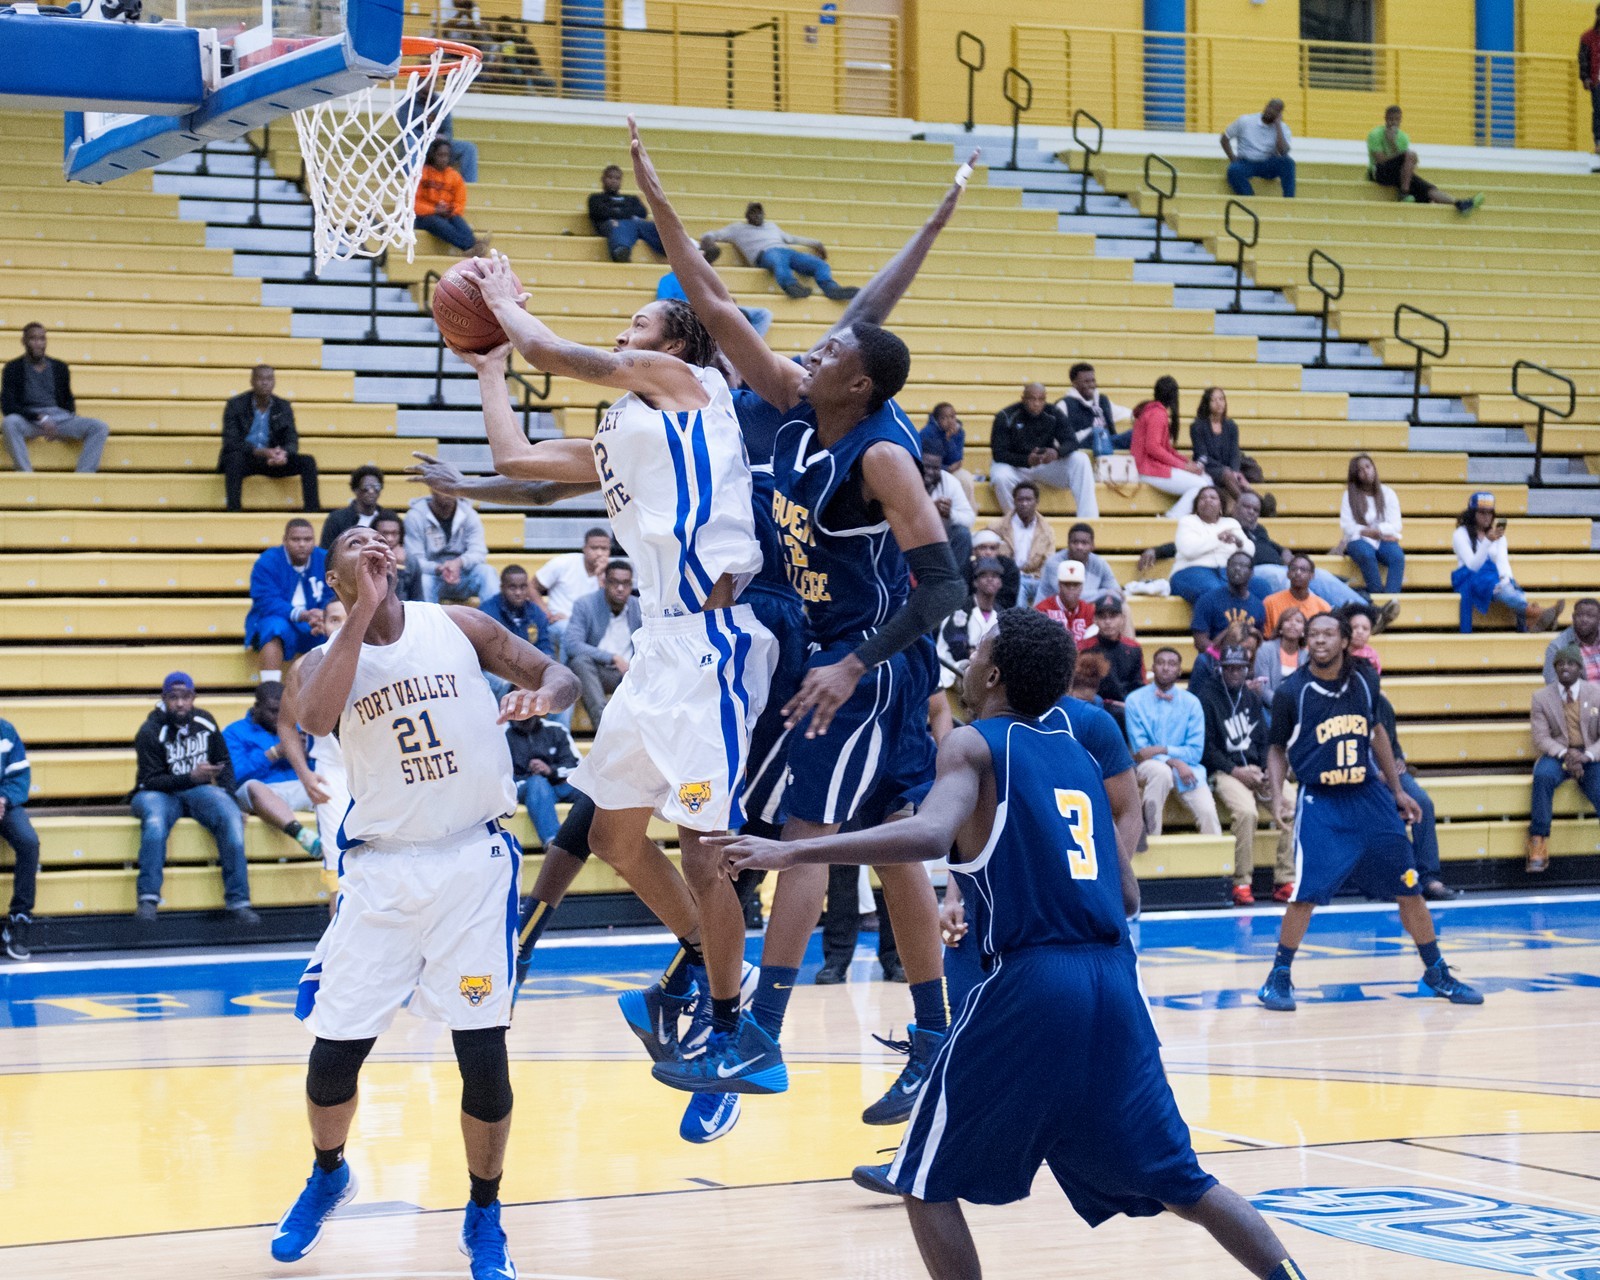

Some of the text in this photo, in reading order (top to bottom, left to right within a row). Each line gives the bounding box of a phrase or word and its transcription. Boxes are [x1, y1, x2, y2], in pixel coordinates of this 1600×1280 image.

[353, 674, 459, 726] FORT VALLEY
[392, 709, 443, 754] 21
[1316, 714, 1368, 744] CARVER
[400, 750, 459, 785] STATE
[1337, 739, 1358, 767] 15
[1053, 788, 1099, 881] 3
